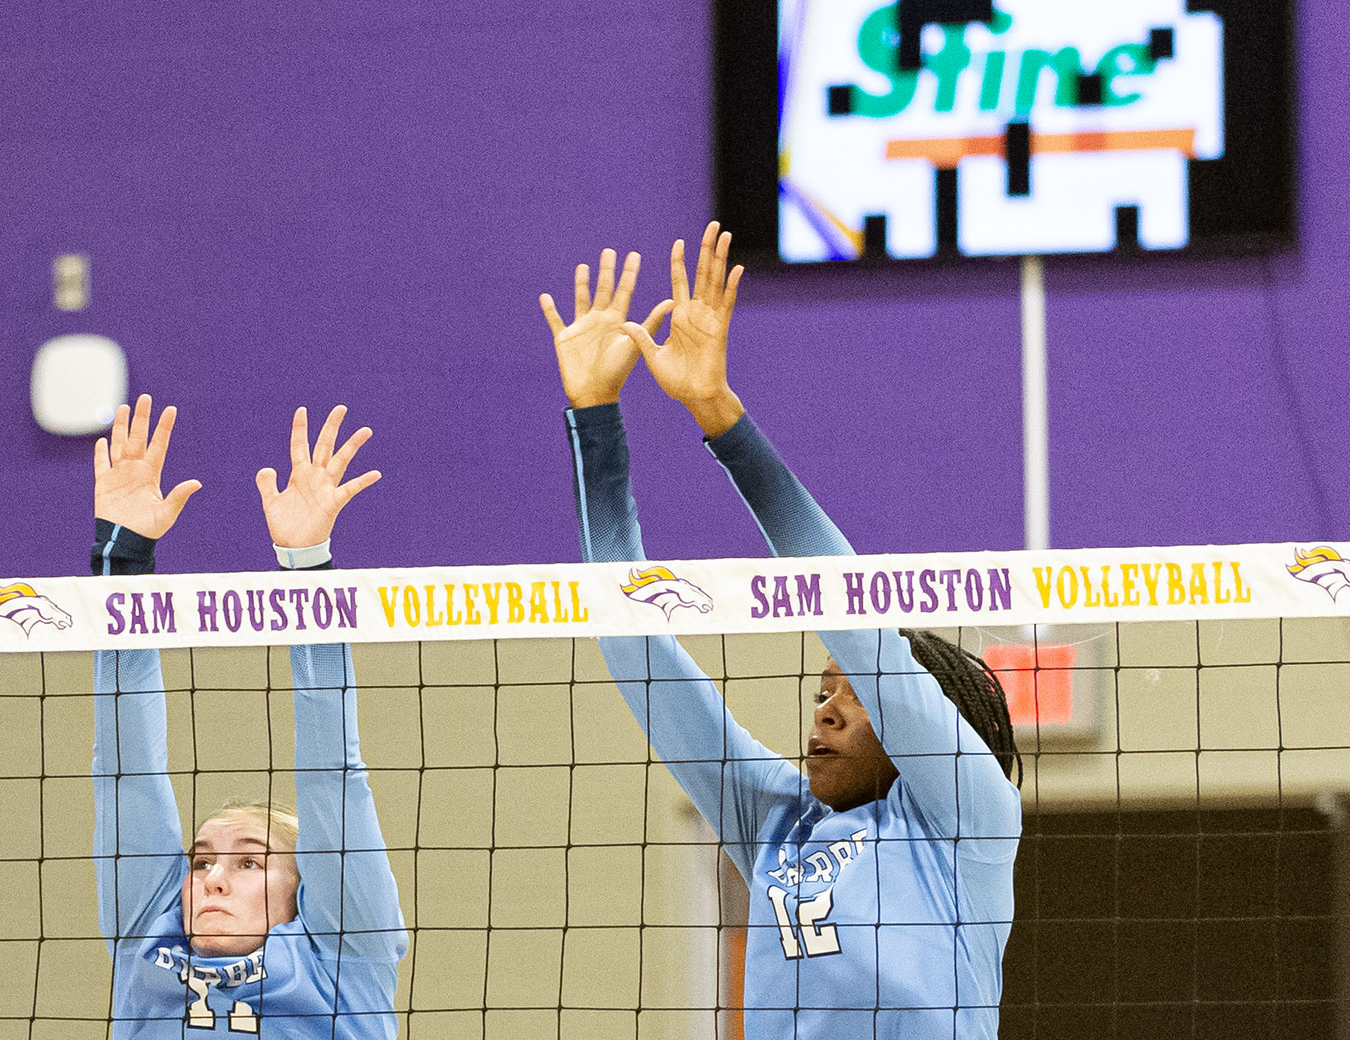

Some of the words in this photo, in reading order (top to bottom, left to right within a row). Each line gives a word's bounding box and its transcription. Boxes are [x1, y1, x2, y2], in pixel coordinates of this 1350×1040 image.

[106, 591, 177, 635] SAM
[197, 586, 358, 633] HOUSTON
[378, 580, 589, 628] VOLLEYBALL
[751, 573, 823, 618] SAM
[844, 567, 1012, 615] HOUSTON
[1032, 560, 1252, 610] VOLLEYBALL
[767, 883, 843, 961] 12
